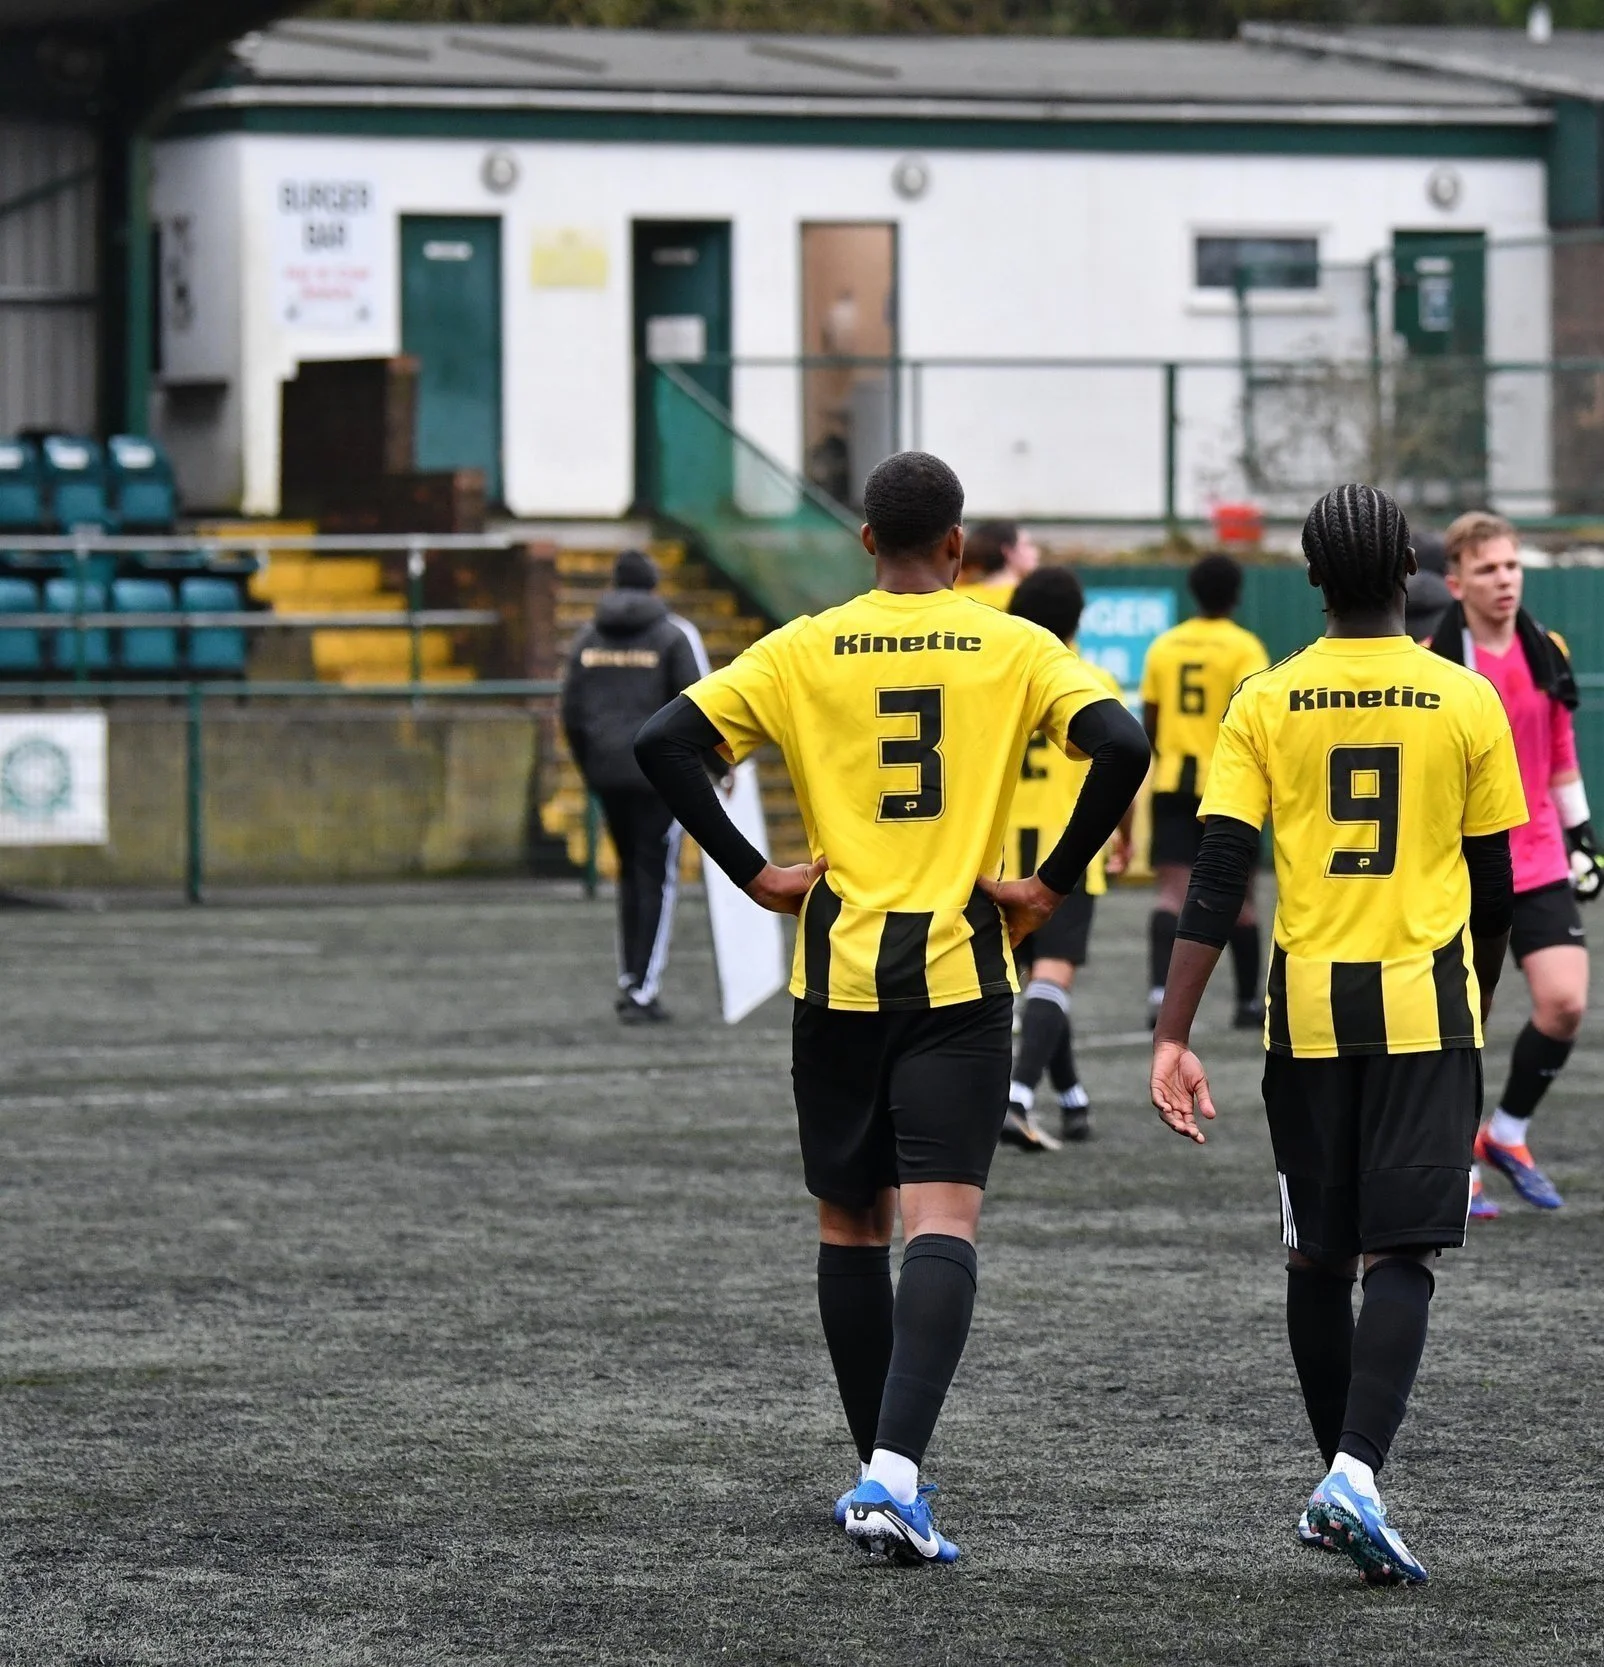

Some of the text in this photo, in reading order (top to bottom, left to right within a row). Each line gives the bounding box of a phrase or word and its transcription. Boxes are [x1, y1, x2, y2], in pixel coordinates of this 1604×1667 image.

[279, 180, 373, 215] BURGER
[302, 220, 350, 252] BAR
[834, 631, 982, 656] Kinetic
[1178, 662, 1206, 717] 6
[1289, 685, 1441, 712] Kinetic
[875, 684, 946, 823] 3
[1324, 742, 1404, 880] 9
